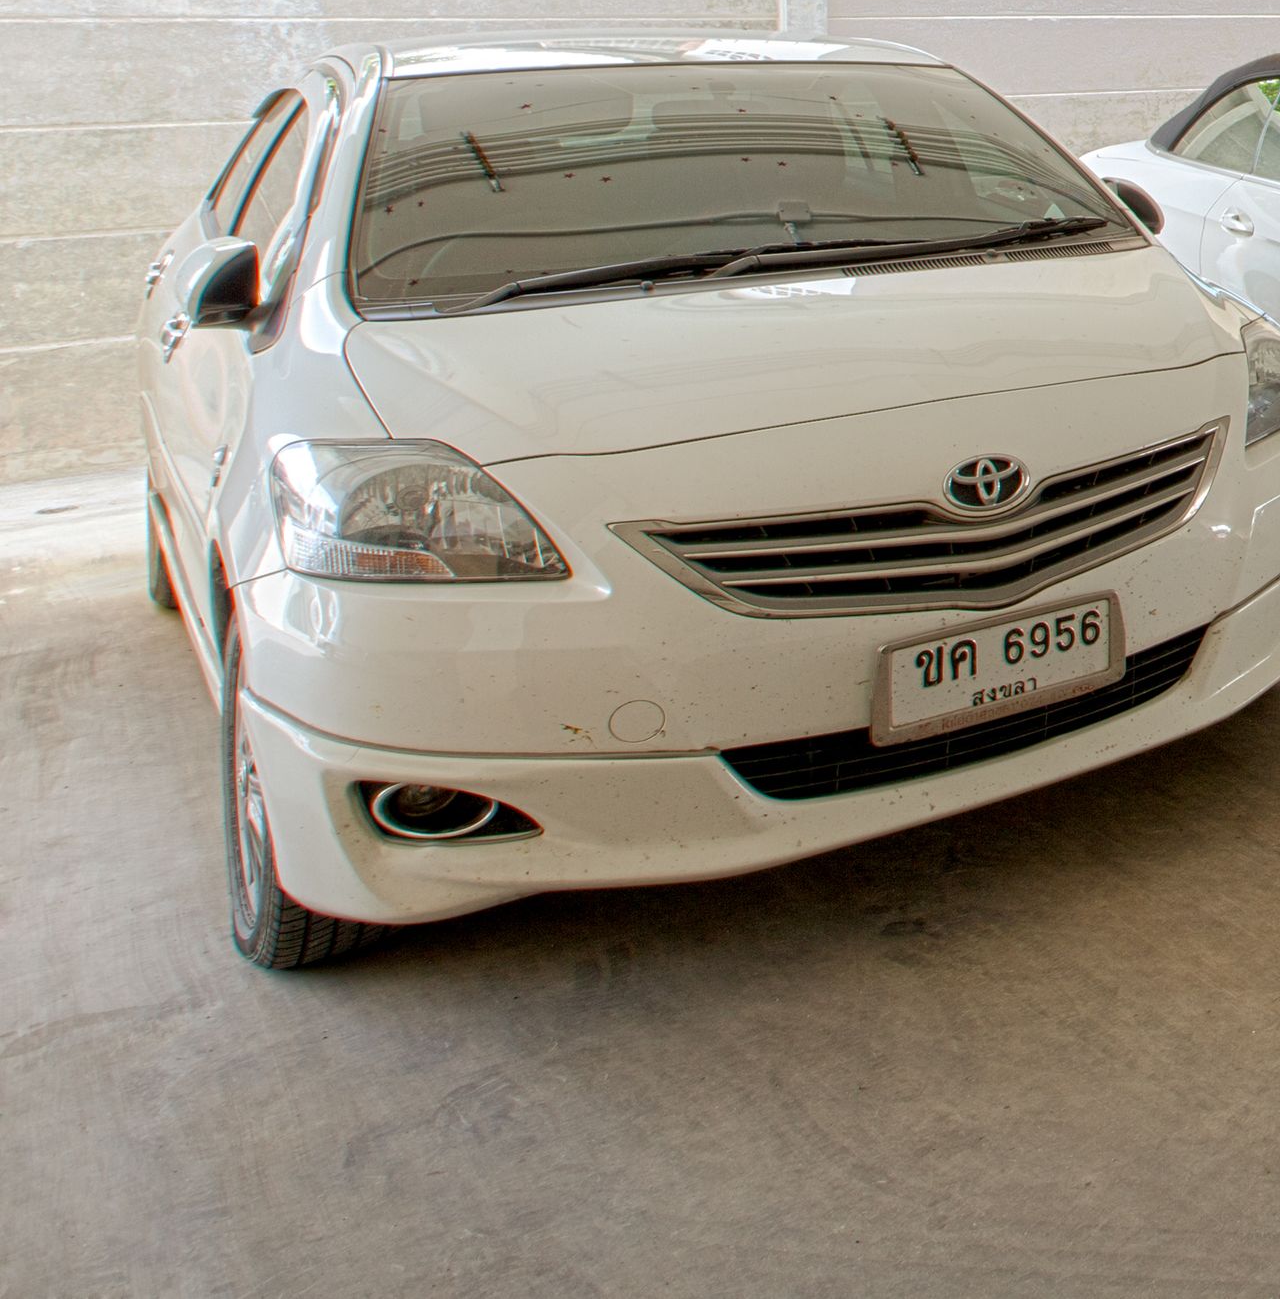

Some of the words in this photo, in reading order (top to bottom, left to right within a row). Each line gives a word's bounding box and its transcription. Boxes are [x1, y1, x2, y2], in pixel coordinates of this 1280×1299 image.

[916, 639, 978, 687] ขค
[1004, 610, 1101, 664] 6956
[972, 677, 1038, 707] สงขลา
